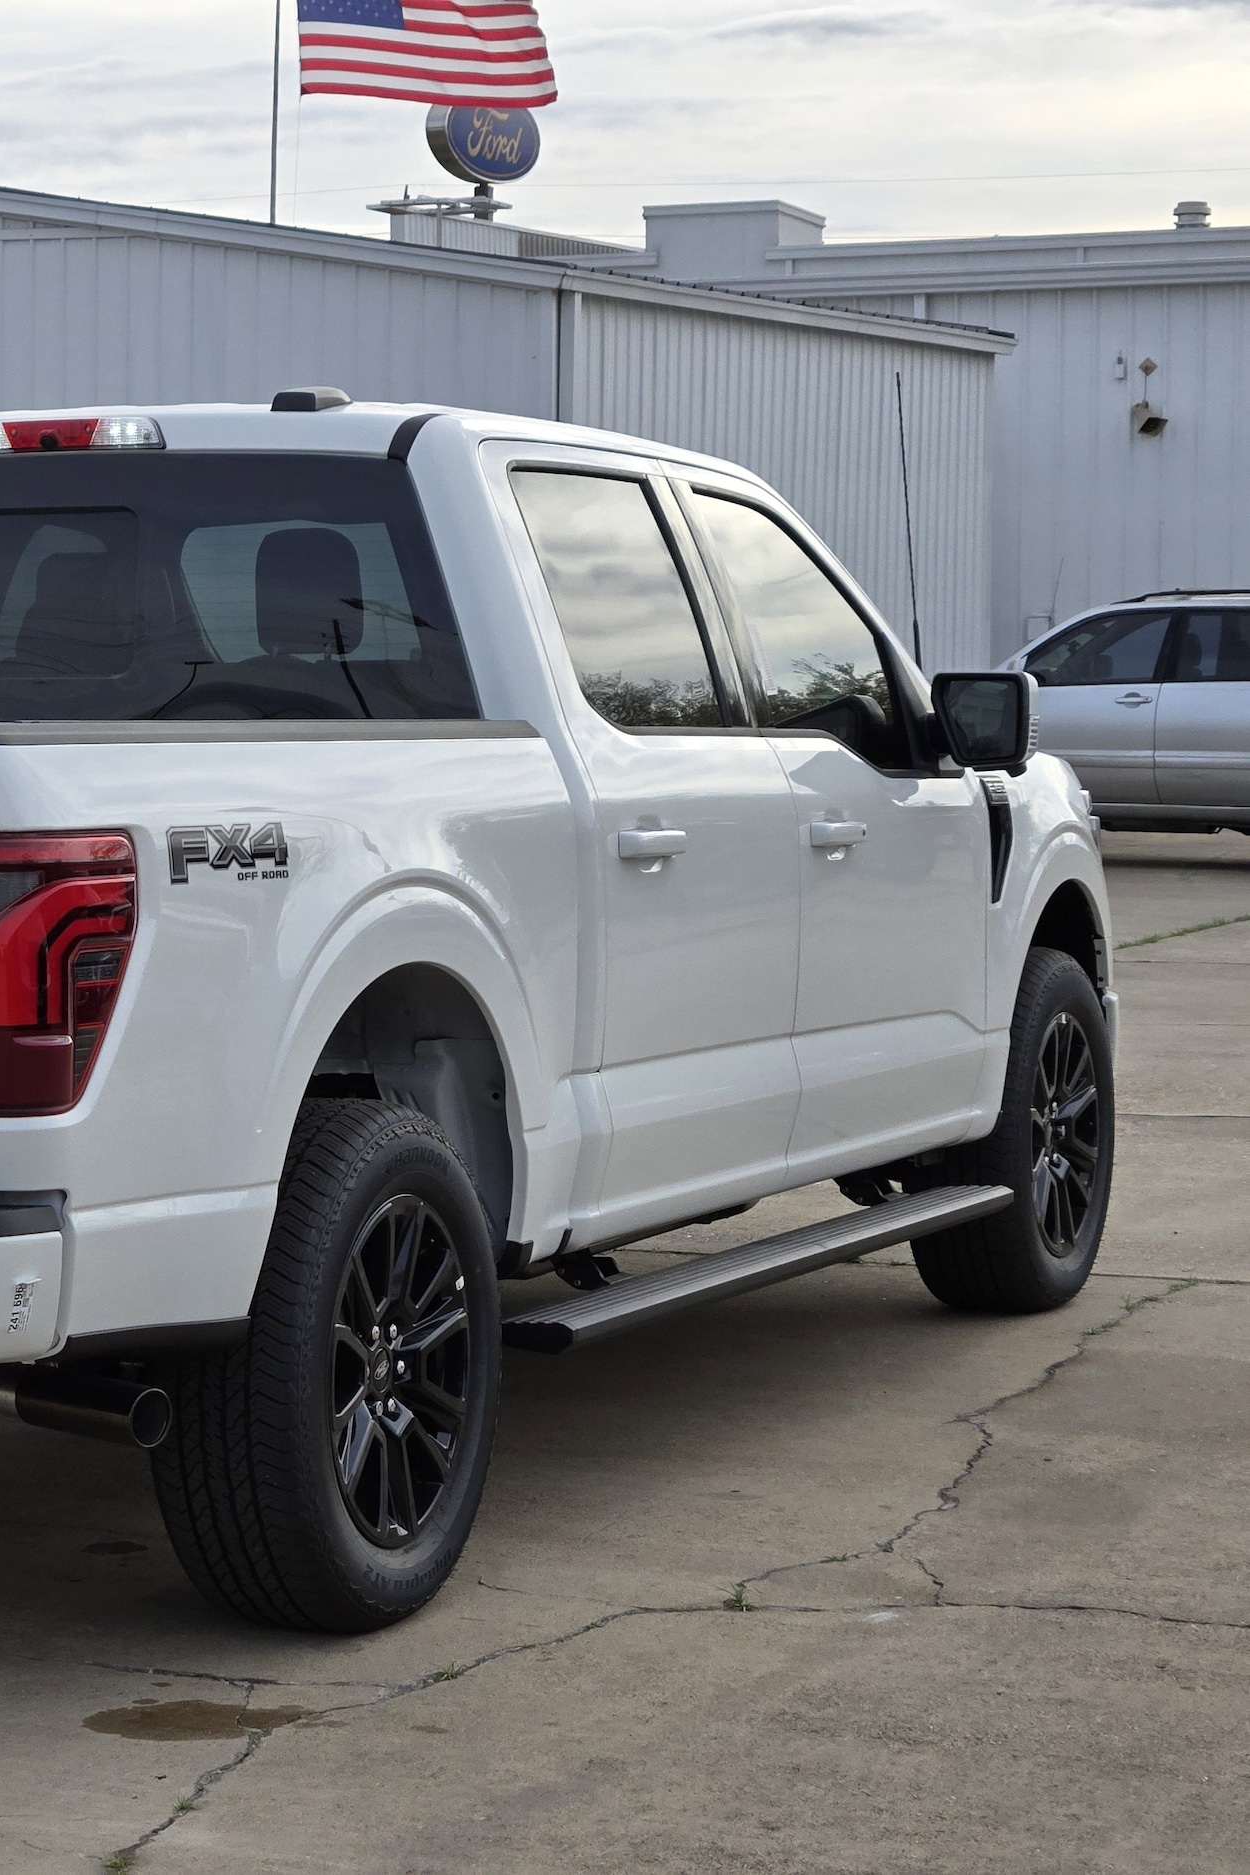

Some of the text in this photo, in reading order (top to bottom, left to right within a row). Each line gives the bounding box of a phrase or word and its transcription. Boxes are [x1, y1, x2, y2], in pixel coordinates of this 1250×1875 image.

[467, 107, 523, 165] Ford
[166, 822, 288, 885] FX4
[237, 870, 289, 881] OFF ROAD
[8, 1312, 20, 1330] 241
